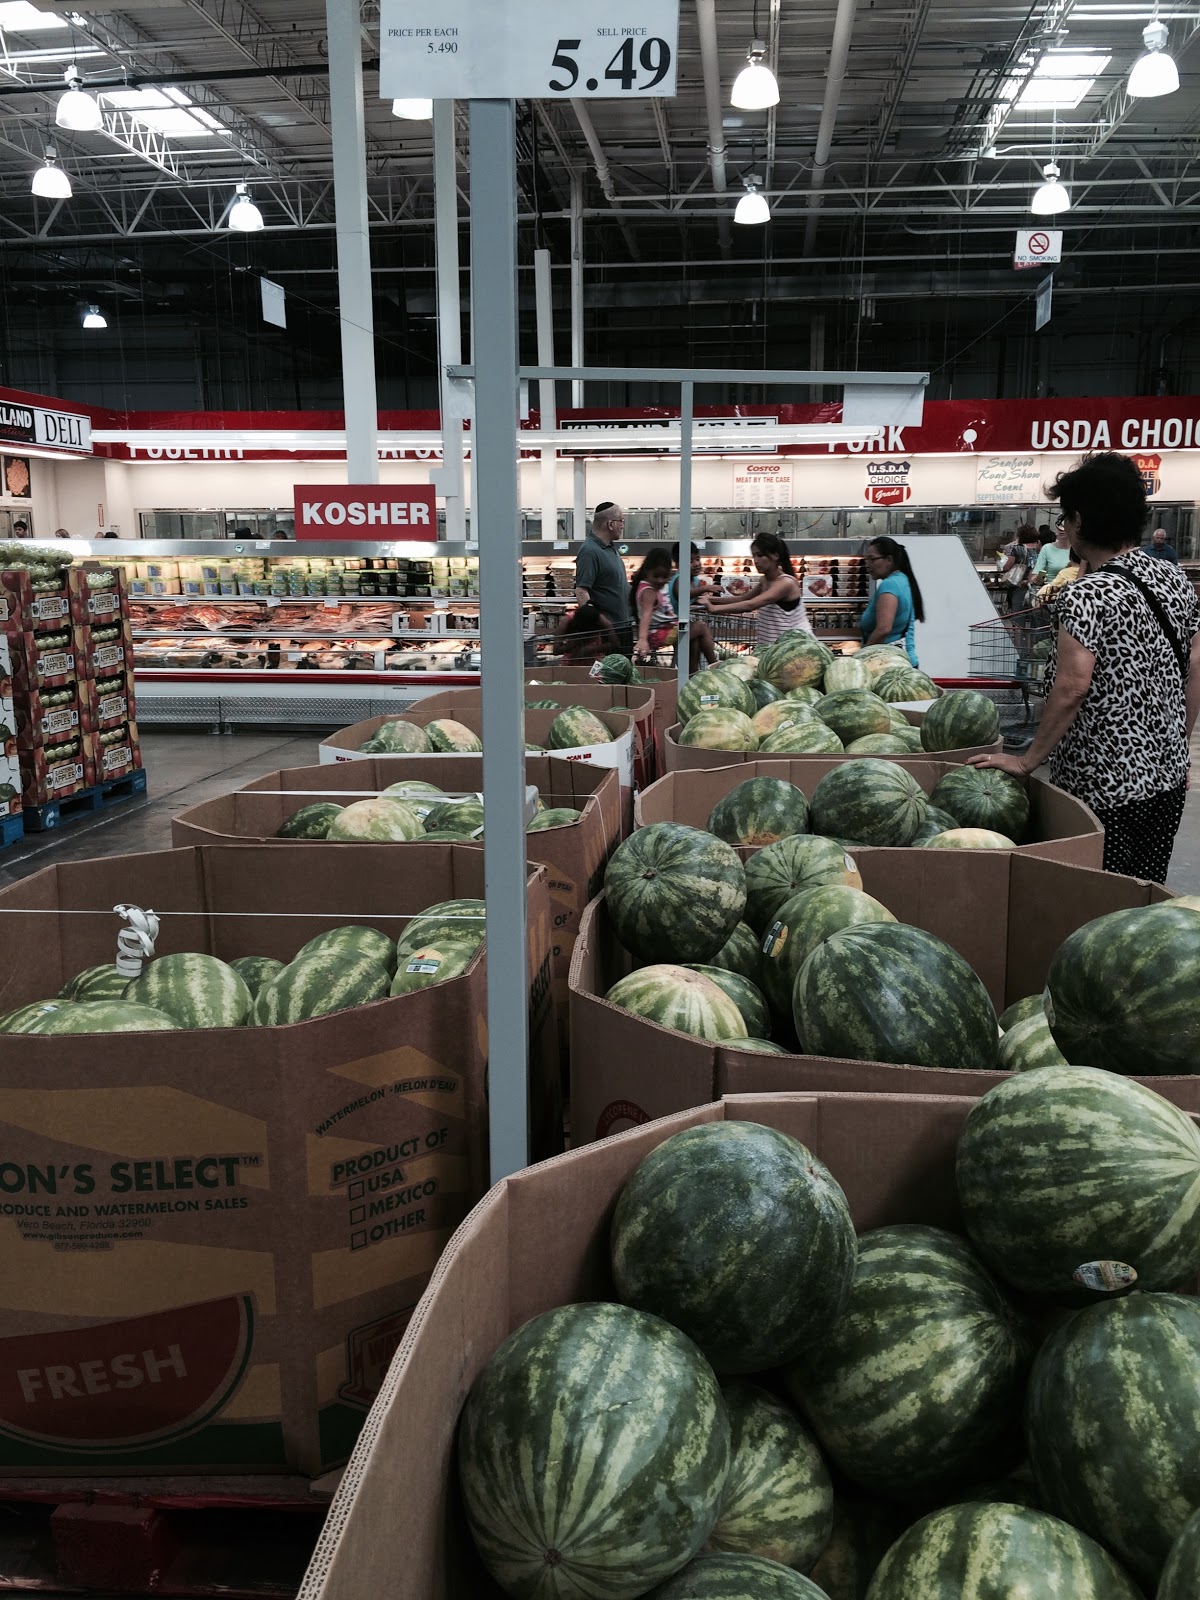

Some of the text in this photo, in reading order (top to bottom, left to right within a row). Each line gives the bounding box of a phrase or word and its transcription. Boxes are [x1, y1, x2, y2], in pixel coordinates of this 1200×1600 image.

[388, 28, 458, 37] PRICE PER EACH
[596, 27, 647, 36] SELL PRICE
[427, 42, 458, 54] 5.490
[548, 37, 671, 92] 5.49
[0, 406, 83, 446] LAND DELI
[1031, 420, 1111, 449] USDA
[869, 465, 908, 473] U.S.D.A.
[985, 457, 1034, 470] Seafood
[870, 475, 907, 484] CHOICE
[978, 469, 1040, 481] Road Show
[994, 480, 1024, 491] Event
[875, 488, 901, 501] Grade
[977, 493, 1014, 501] SEPTEMBER
[302, 501, 431, 526] KOSHER
[41, 605, 61, 614] APPLES
[46, 661, 66, 670] APPLES
[50, 717, 71, 728] APPLES
[55, 771, 76, 781] APPLES
[315, 1088, 385, 1136] WATERMELON
[429, 1079, 456, 1093] D'EAU
[333, 1127, 449, 1182] PRODUCT OF
[367, 1168, 404, 1192] USA
[369, 1180, 437, 1217] MEXICO
[56, 1205, 89, 1217] AND
[94, 1200, 200, 1216] WATERMELON
[205, 1197, 248, 1210] SALES
[42, 1219, 76, 1231] Beach,
[80, 1220, 115, 1229] Florida
[369, 1208, 426, 1241] OTHER
[23, 1230, 143, 1241] www.gibsonproduce.com
[16, 1343, 188, 1403] FRESH
